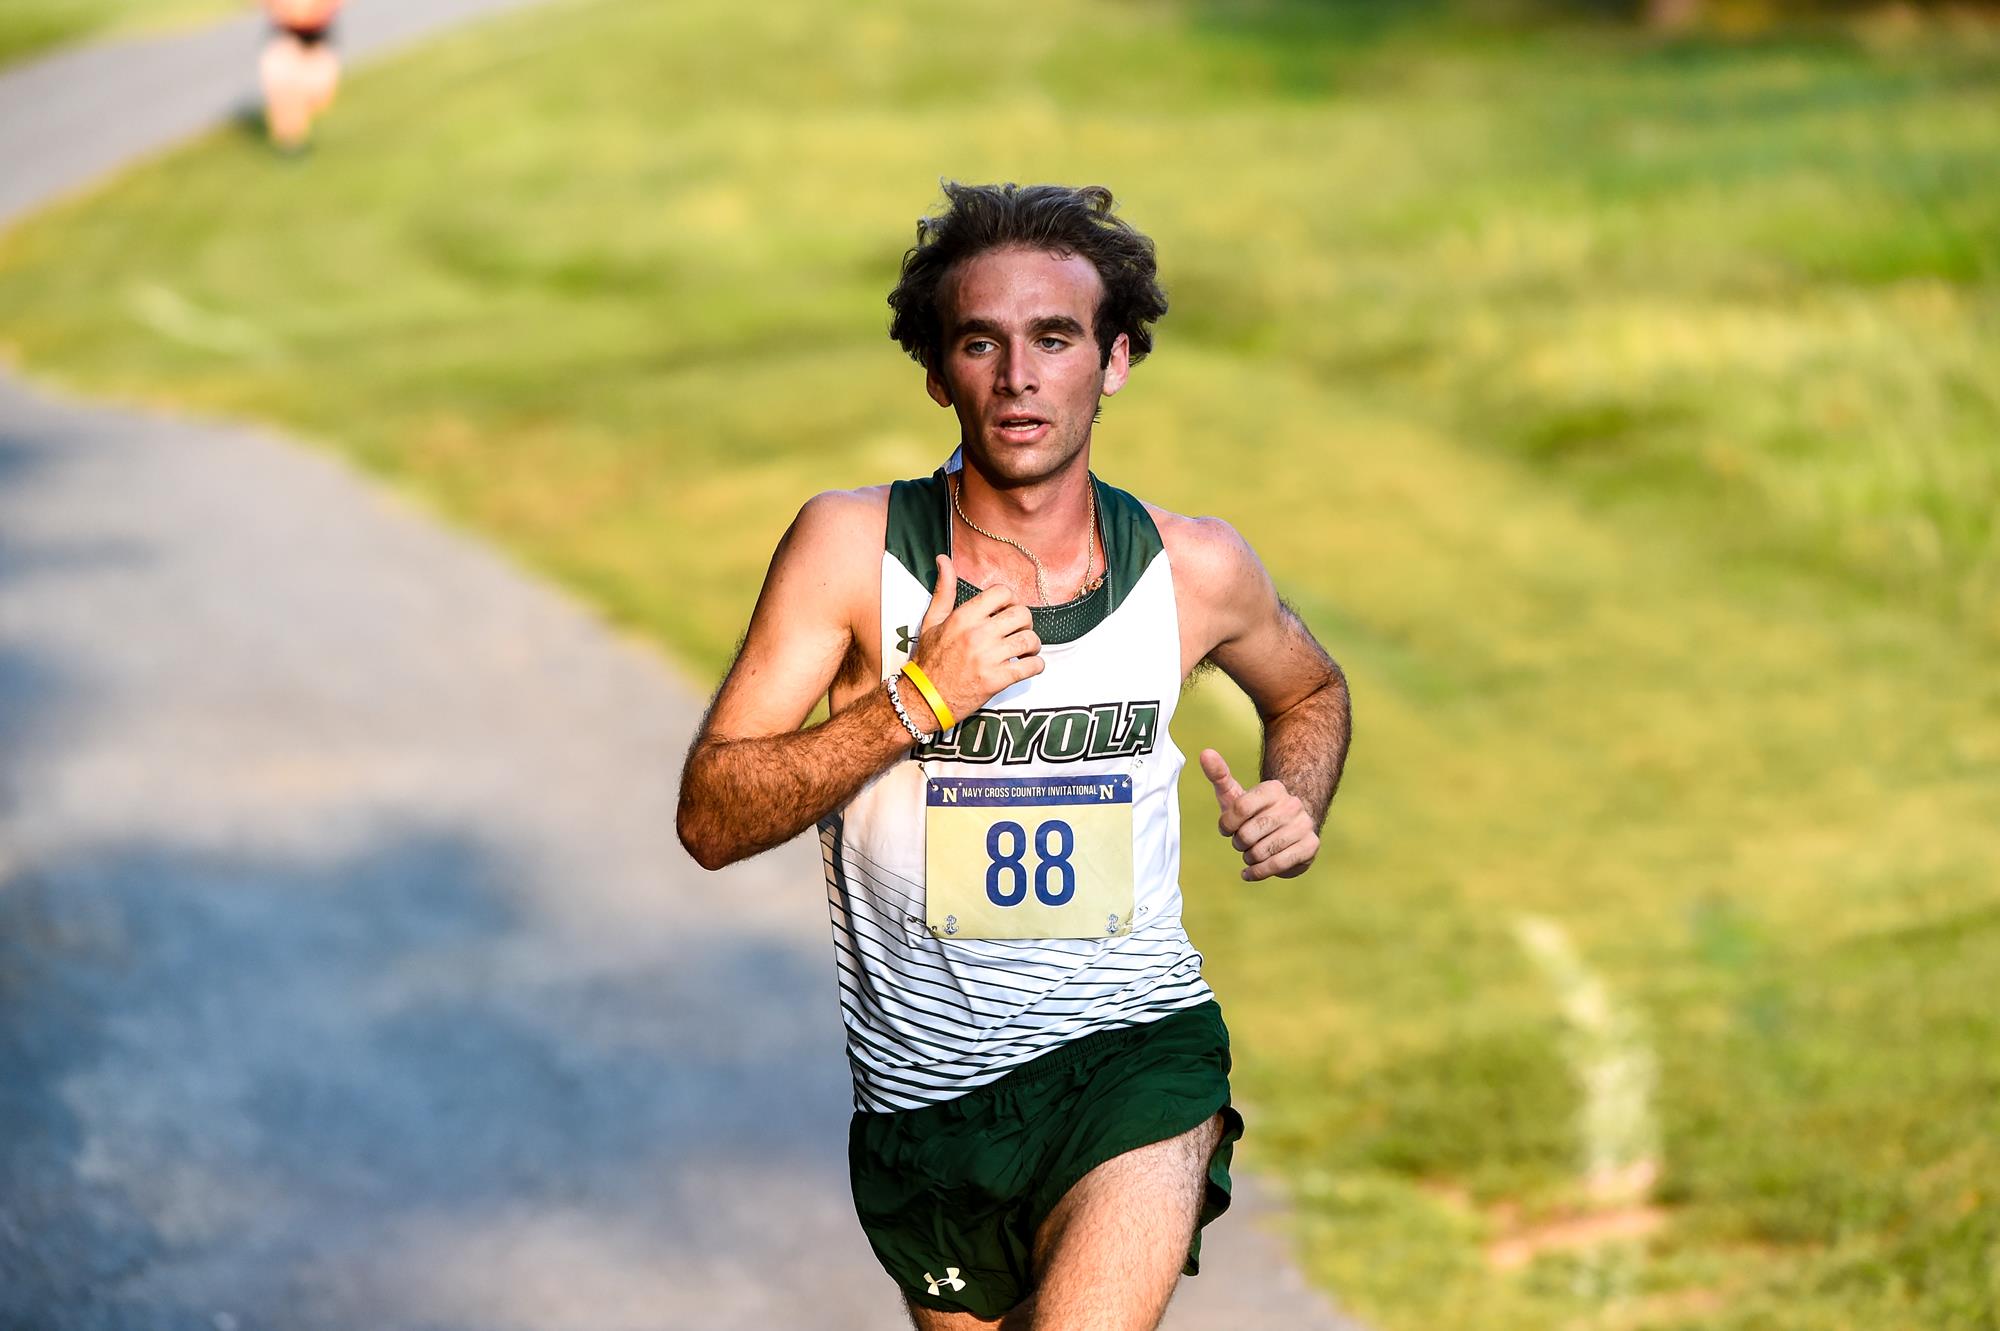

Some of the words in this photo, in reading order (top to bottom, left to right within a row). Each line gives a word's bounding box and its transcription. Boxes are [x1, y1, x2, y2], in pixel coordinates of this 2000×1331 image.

[942, 787, 958, 803] N
[962, 787, 983, 798] NAVY
[984, 787, 1010, 798] CROSS
[1011, 786, 1046, 798] COUNTRY
[1047, 784, 1098, 797] INVITATIONAL
[1098, 784, 1114, 800] N
[985, 819, 1076, 907] 88
